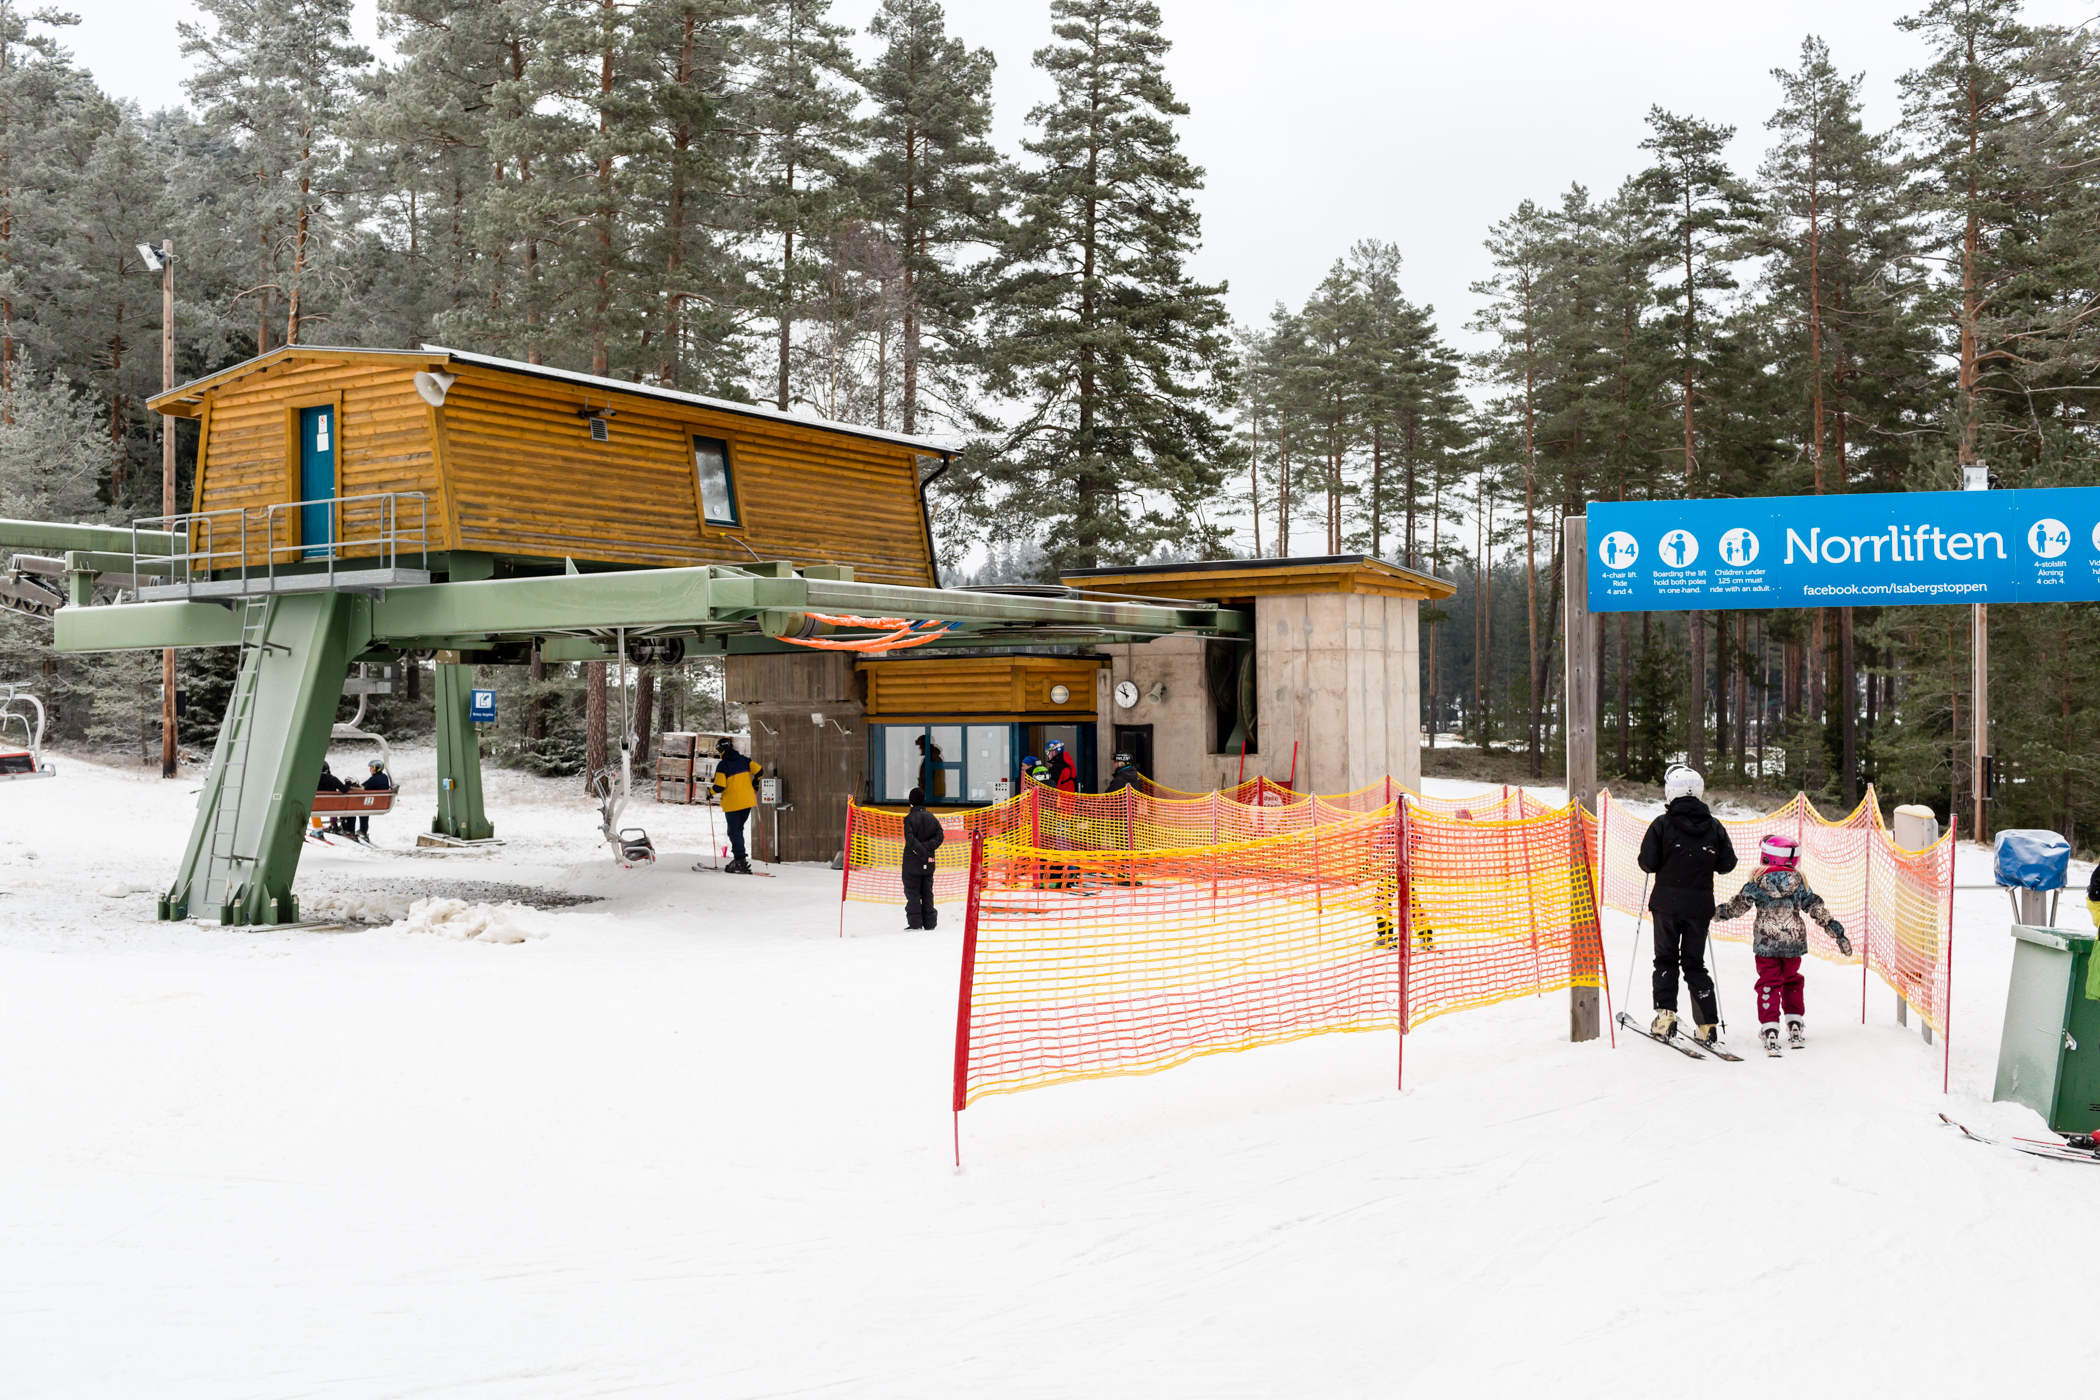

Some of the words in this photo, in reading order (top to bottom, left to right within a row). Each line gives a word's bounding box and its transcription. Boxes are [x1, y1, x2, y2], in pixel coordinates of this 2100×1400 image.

[1784, 524, 2007, 564] Norrliften
[1602, 571, 1626, 579] 4-chair
[1652, 570, 1684, 579] Boarding
[1697, 569, 1707, 577] lift
[1714, 568, 1744, 576] Children
[1745, 568, 1767, 576] under
[2037, 568, 2064, 578] Åkning
[1670, 578, 1687, 586] both
[1687, 578, 1707, 587] poles
[1718, 577, 1731, 585] 125
[1744, 576, 1763, 584] must
[1709, 585, 1724, 593] ride
[1724, 585, 1741, 593] with
